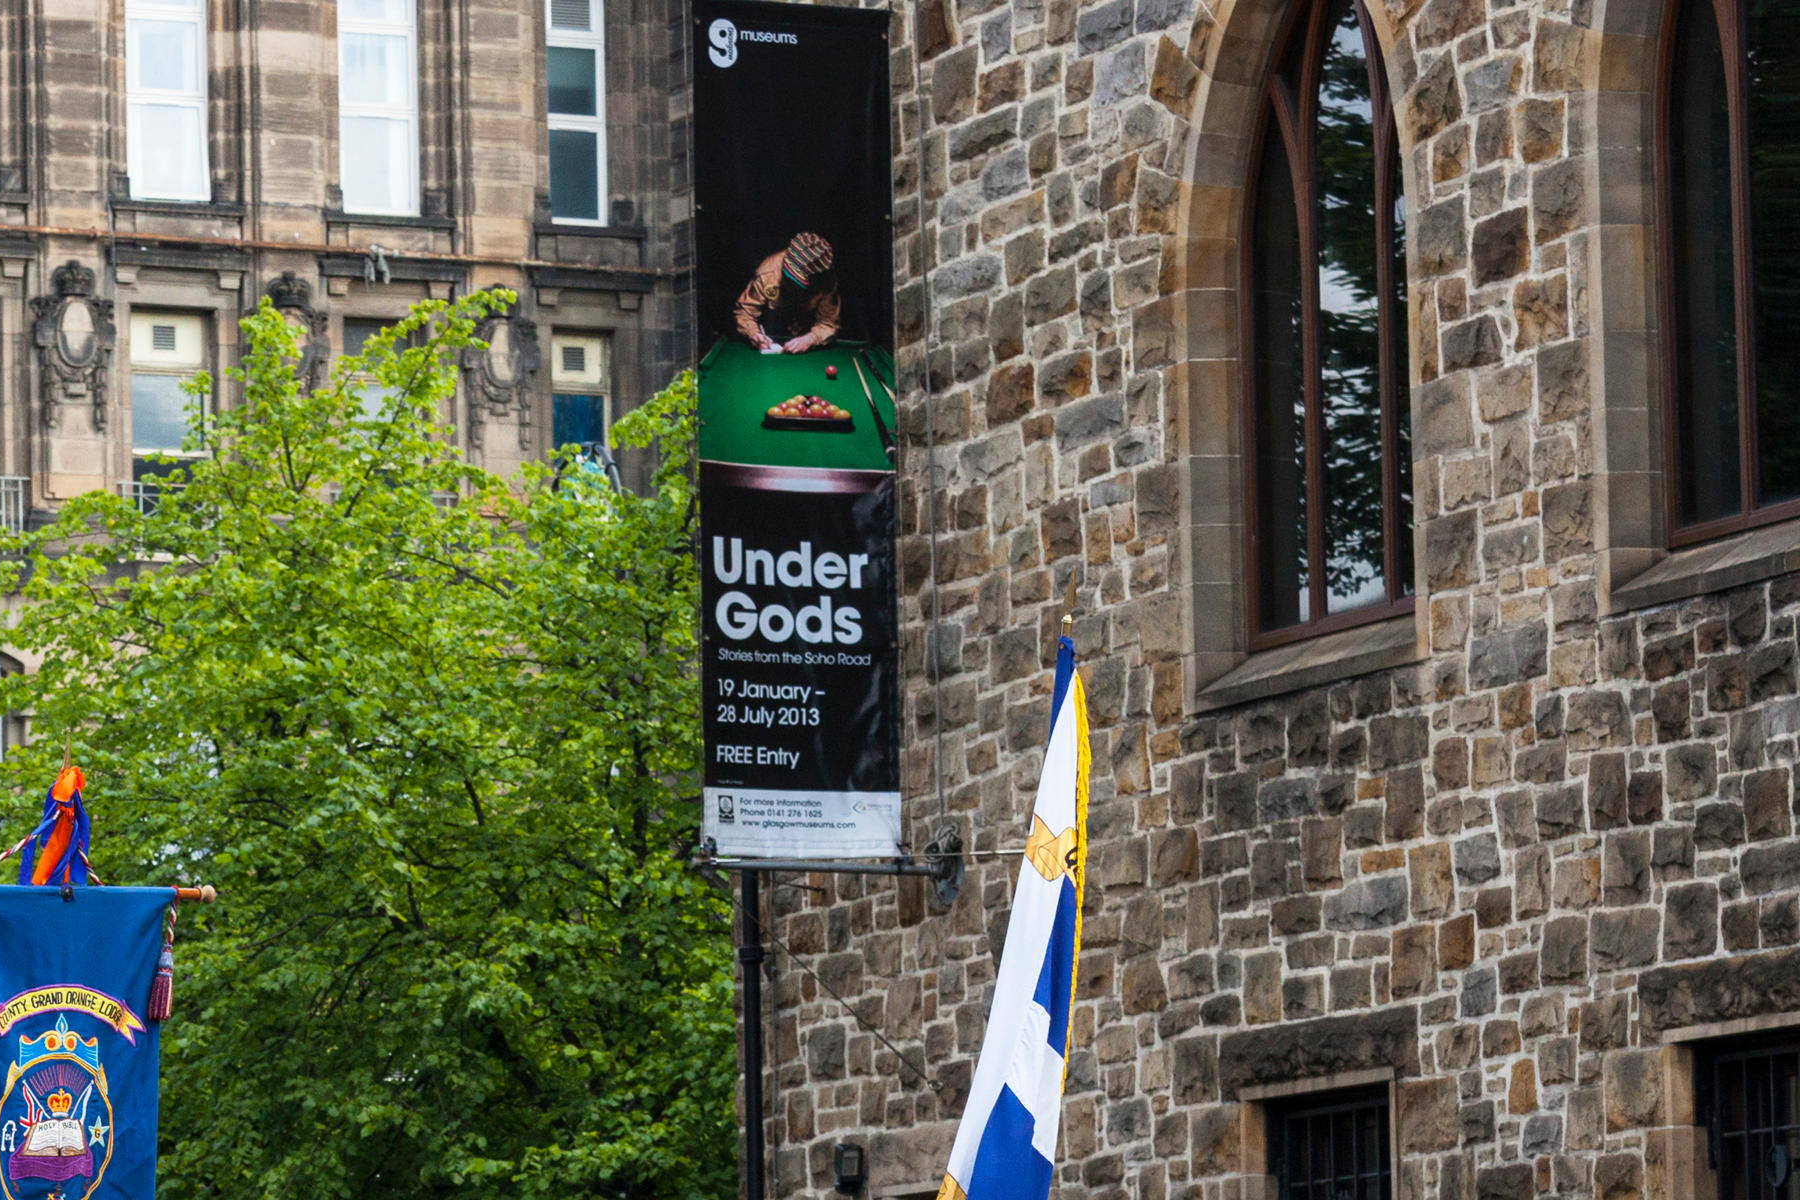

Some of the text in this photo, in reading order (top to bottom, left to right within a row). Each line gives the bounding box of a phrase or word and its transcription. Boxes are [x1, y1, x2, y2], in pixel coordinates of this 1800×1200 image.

[740, 30, 798, 44] museums
[712, 535, 869, 589] Under
[715, 591, 863, 645] Gods
[718, 647, 871, 666] Stories from the Soho Road
[717, 678, 734, 696] 19
[737, 680, 811, 704] January
[716, 704, 820, 728] 28 July 2013
[716, 744, 800, 770] FREE Entry
[739, 797, 751, 806] For
[776, 798, 822, 807] information
[740, 808, 766, 817] Phone
[31, 991, 63, 1008] GRAND
